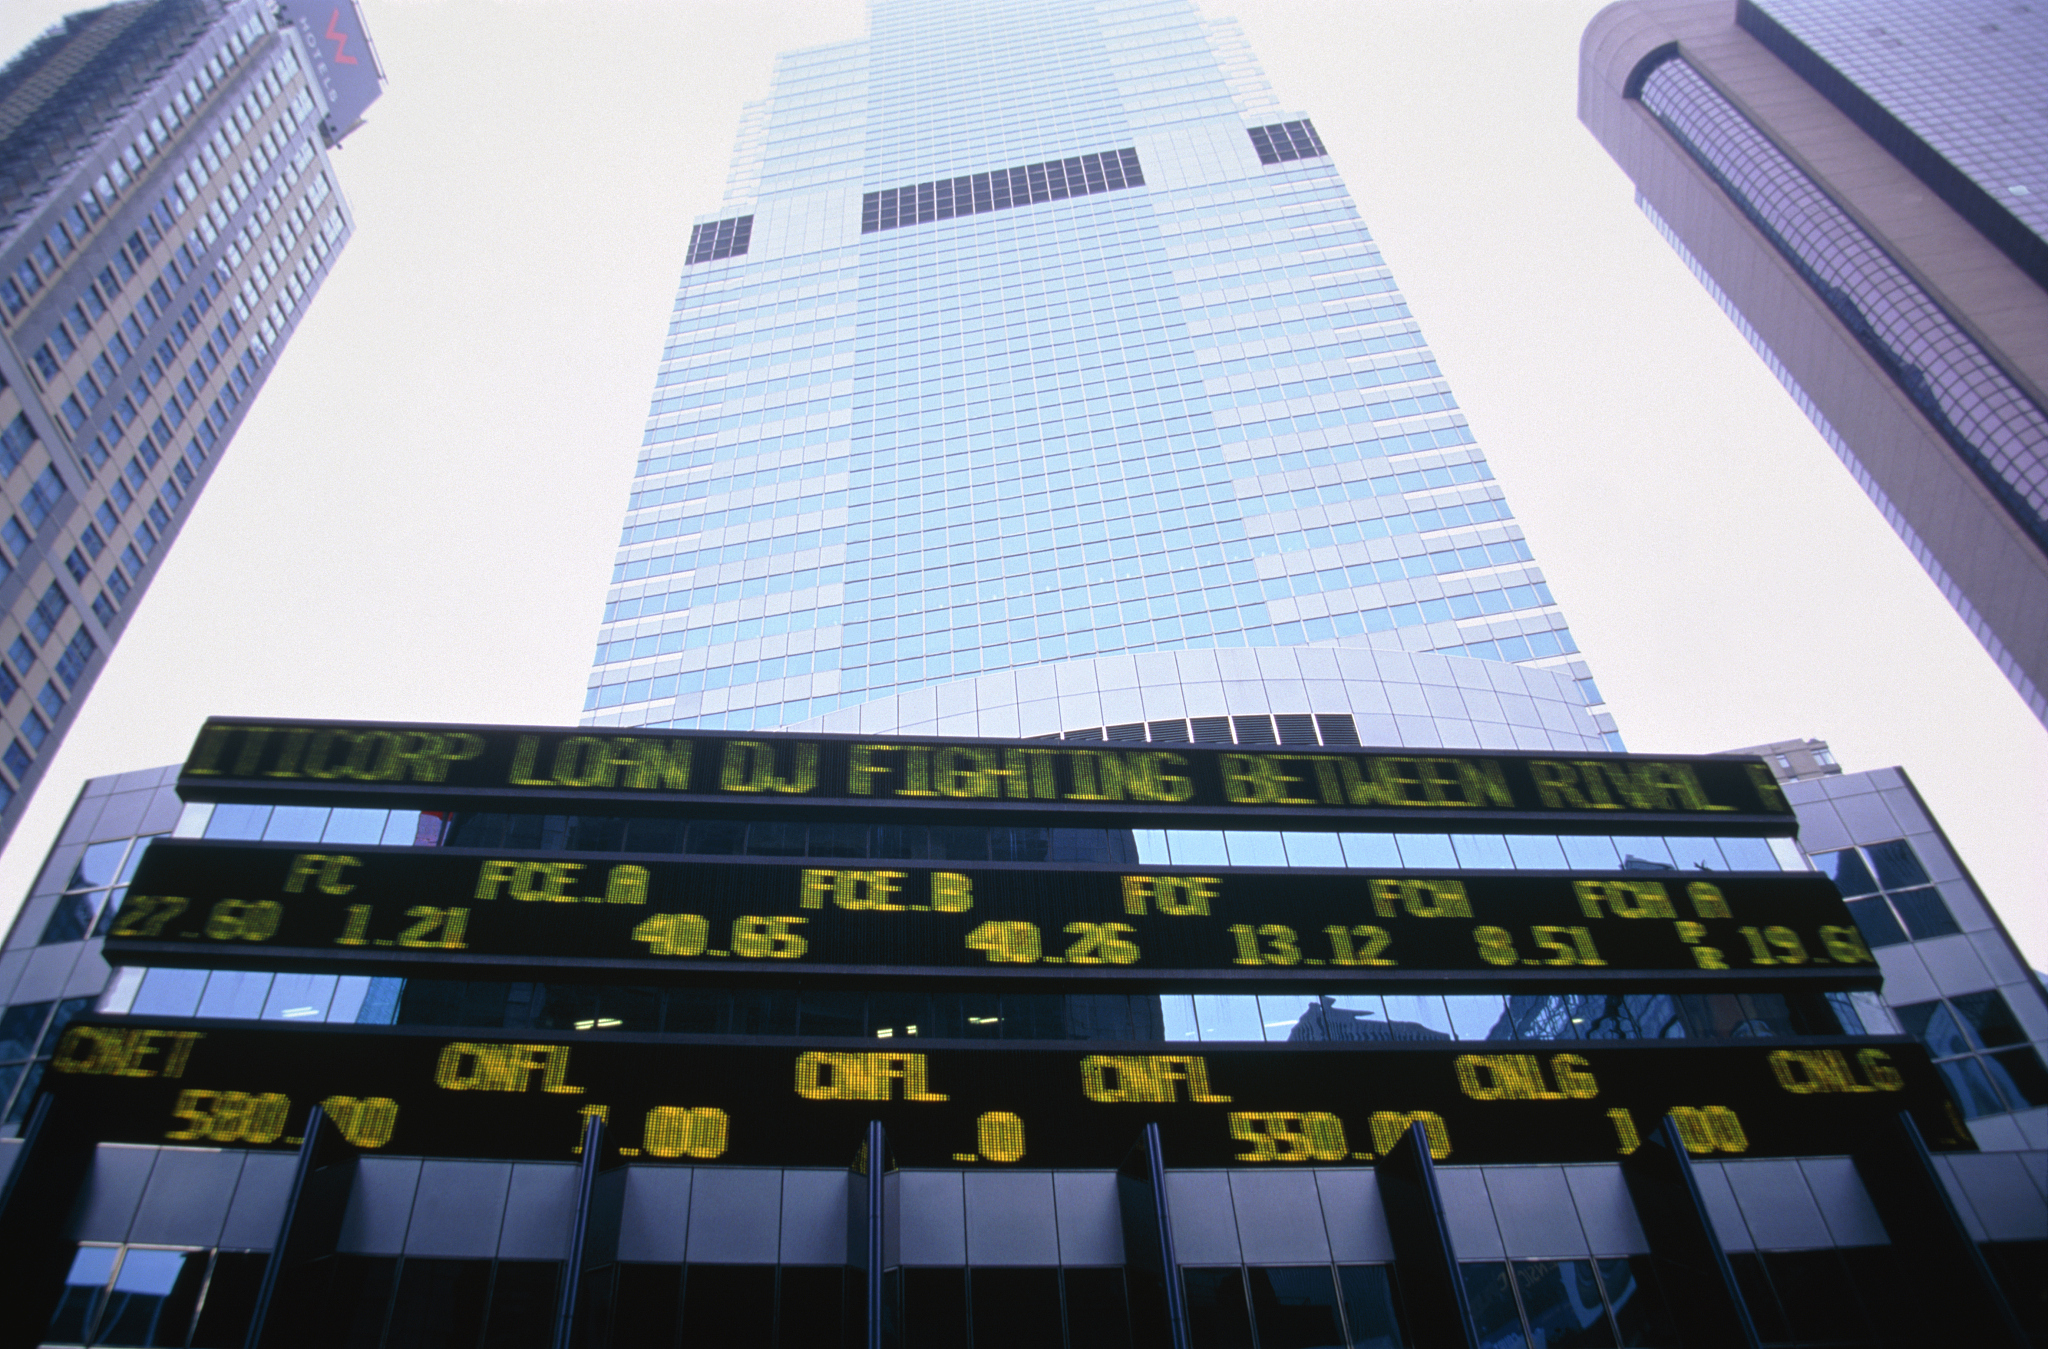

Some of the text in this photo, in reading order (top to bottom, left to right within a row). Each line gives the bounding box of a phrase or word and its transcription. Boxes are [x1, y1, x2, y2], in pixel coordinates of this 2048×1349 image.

[300, 16, 338, 102] HOTELS
[324, 7, 358, 65] W
[508, 735, 694, 790] LOAN
[848, 743, 1195, 803] FIGHTING
[1217, 752, 1515, 809] BETWEEN
[1527, 759, 1738, 811] RIVAL
[335, 903, 471, 950] 1.21
[1228, 923, 1396, 967] 13.12
[1472, 926, 1609, 967] 8.51
